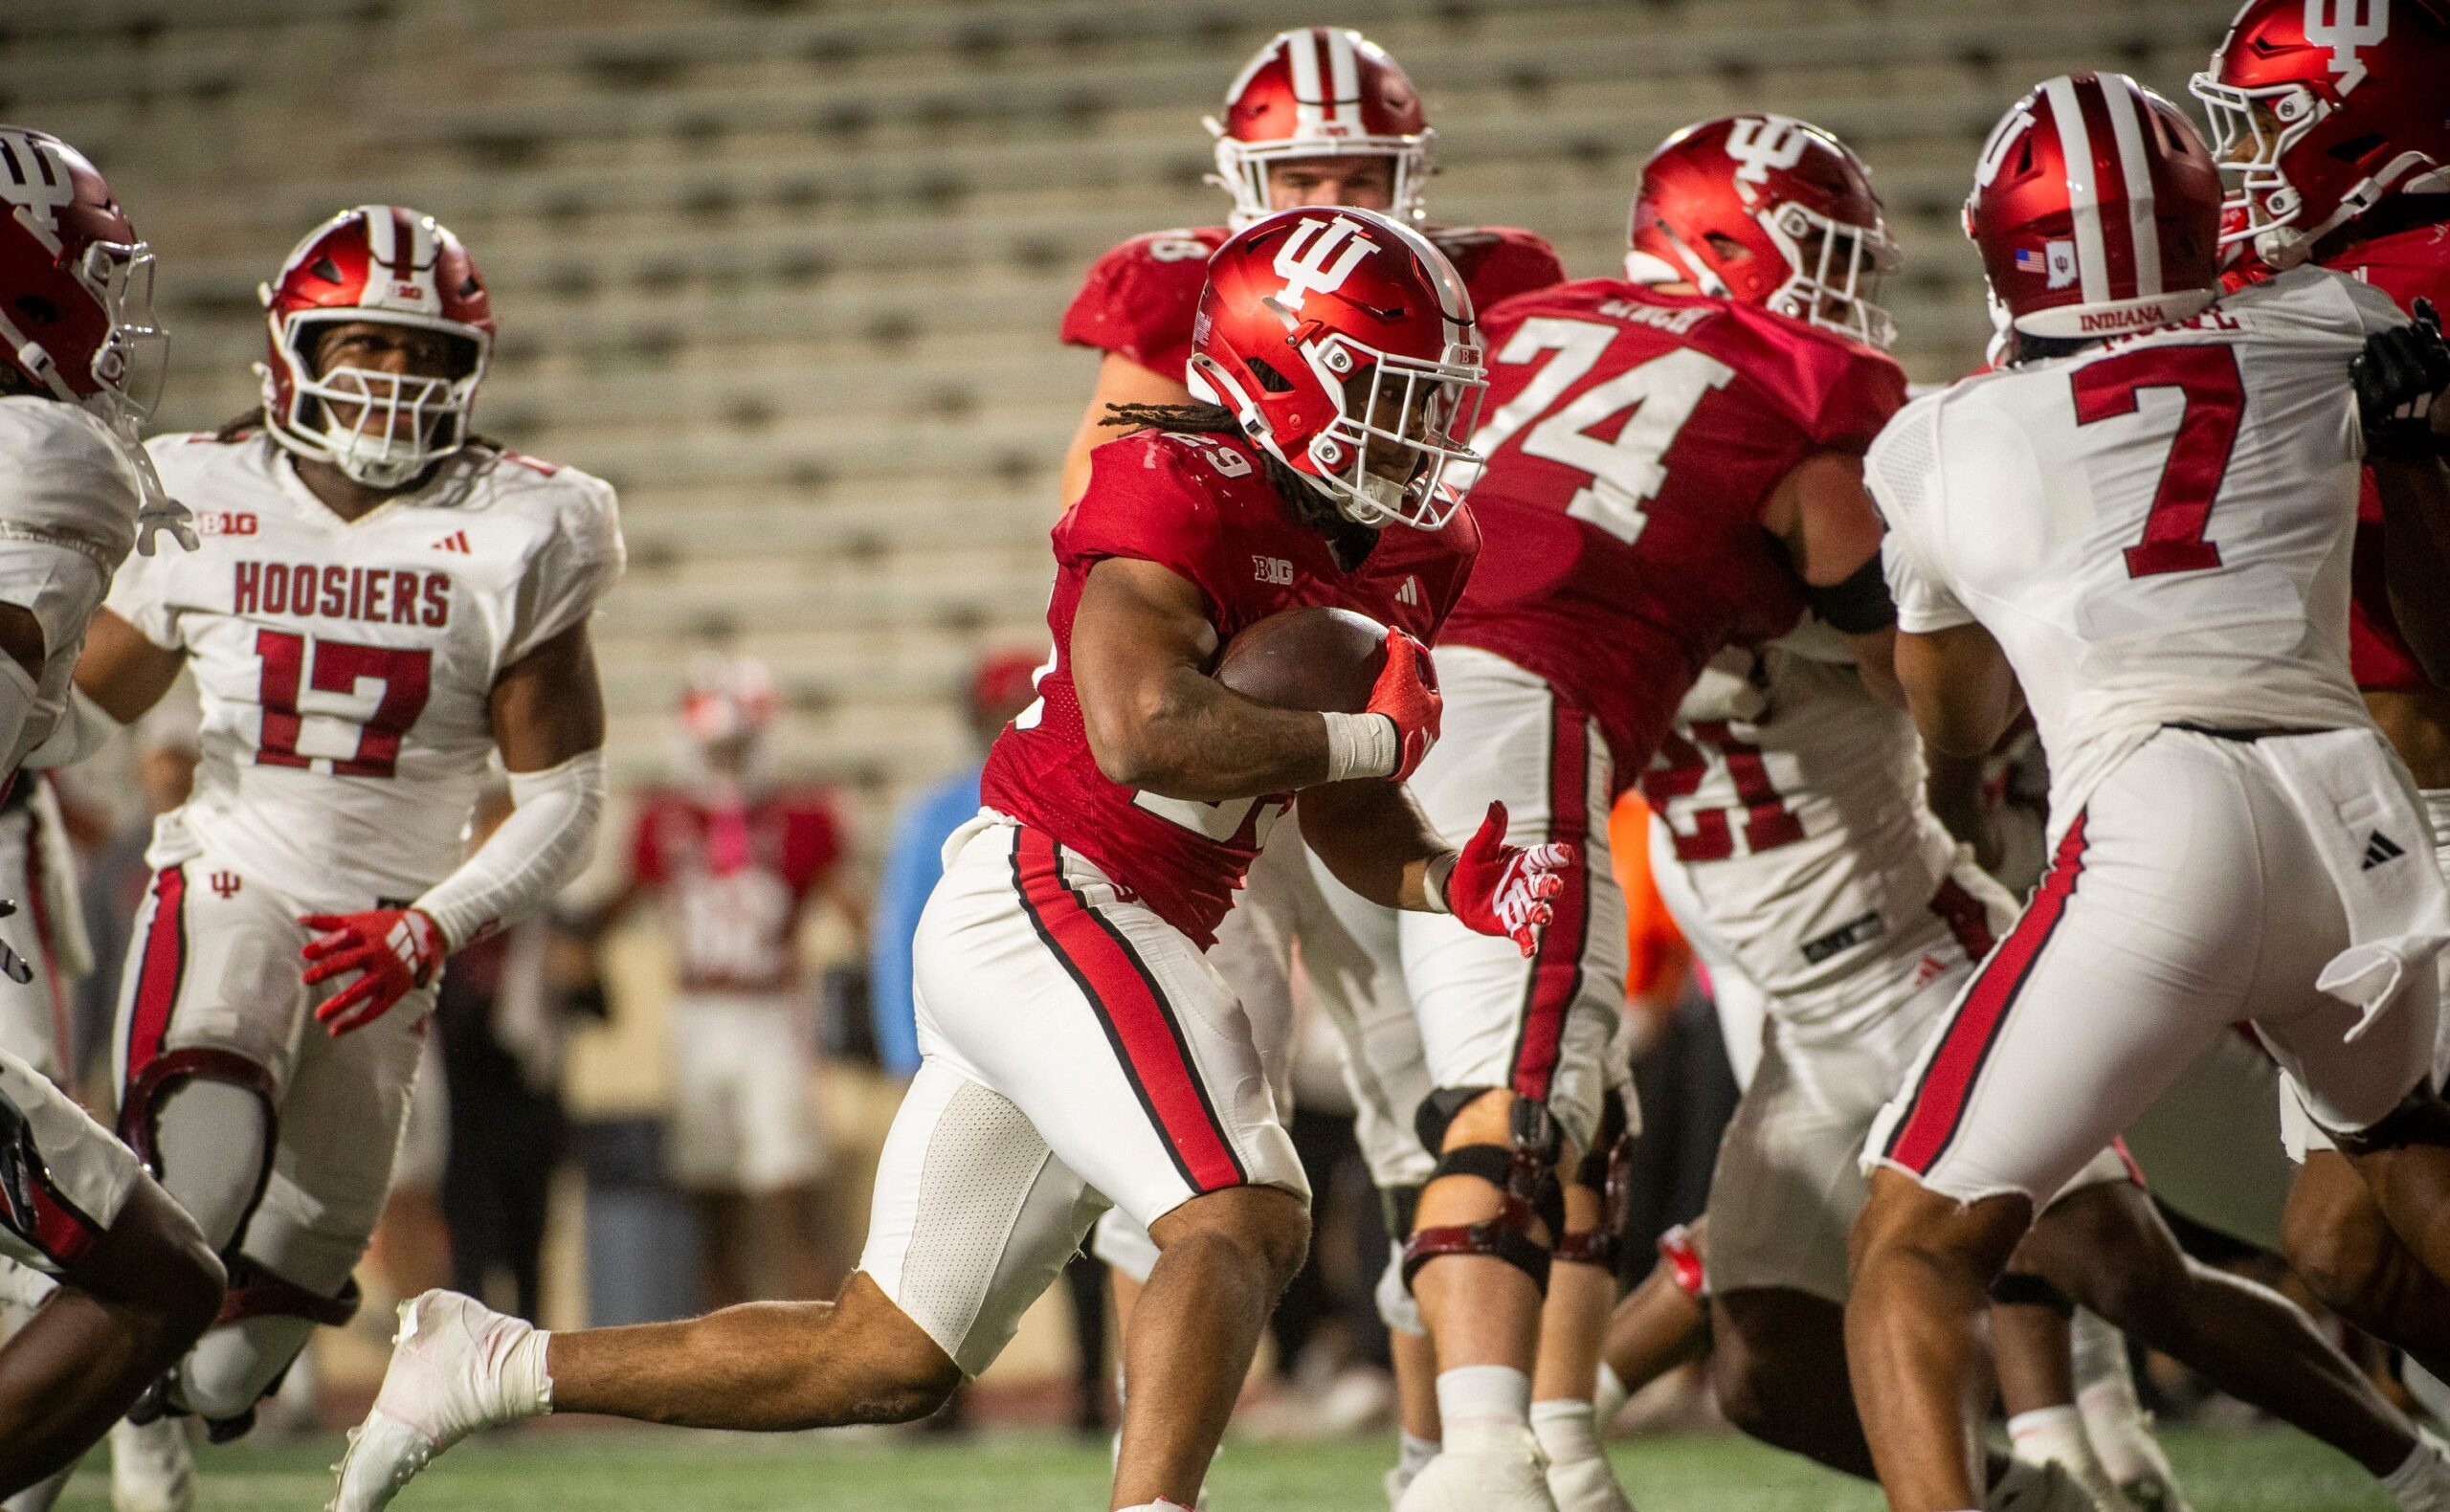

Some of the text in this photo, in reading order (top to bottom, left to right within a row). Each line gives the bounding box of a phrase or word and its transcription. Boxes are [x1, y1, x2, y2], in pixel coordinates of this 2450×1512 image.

[2080, 305, 2166, 332] INDIANA
[1437, 317, 1736, 546] 74
[2071, 343, 2246, 579] 7
[234, 562, 452, 628] HOOSIERS
[255, 629, 433, 778] 17
